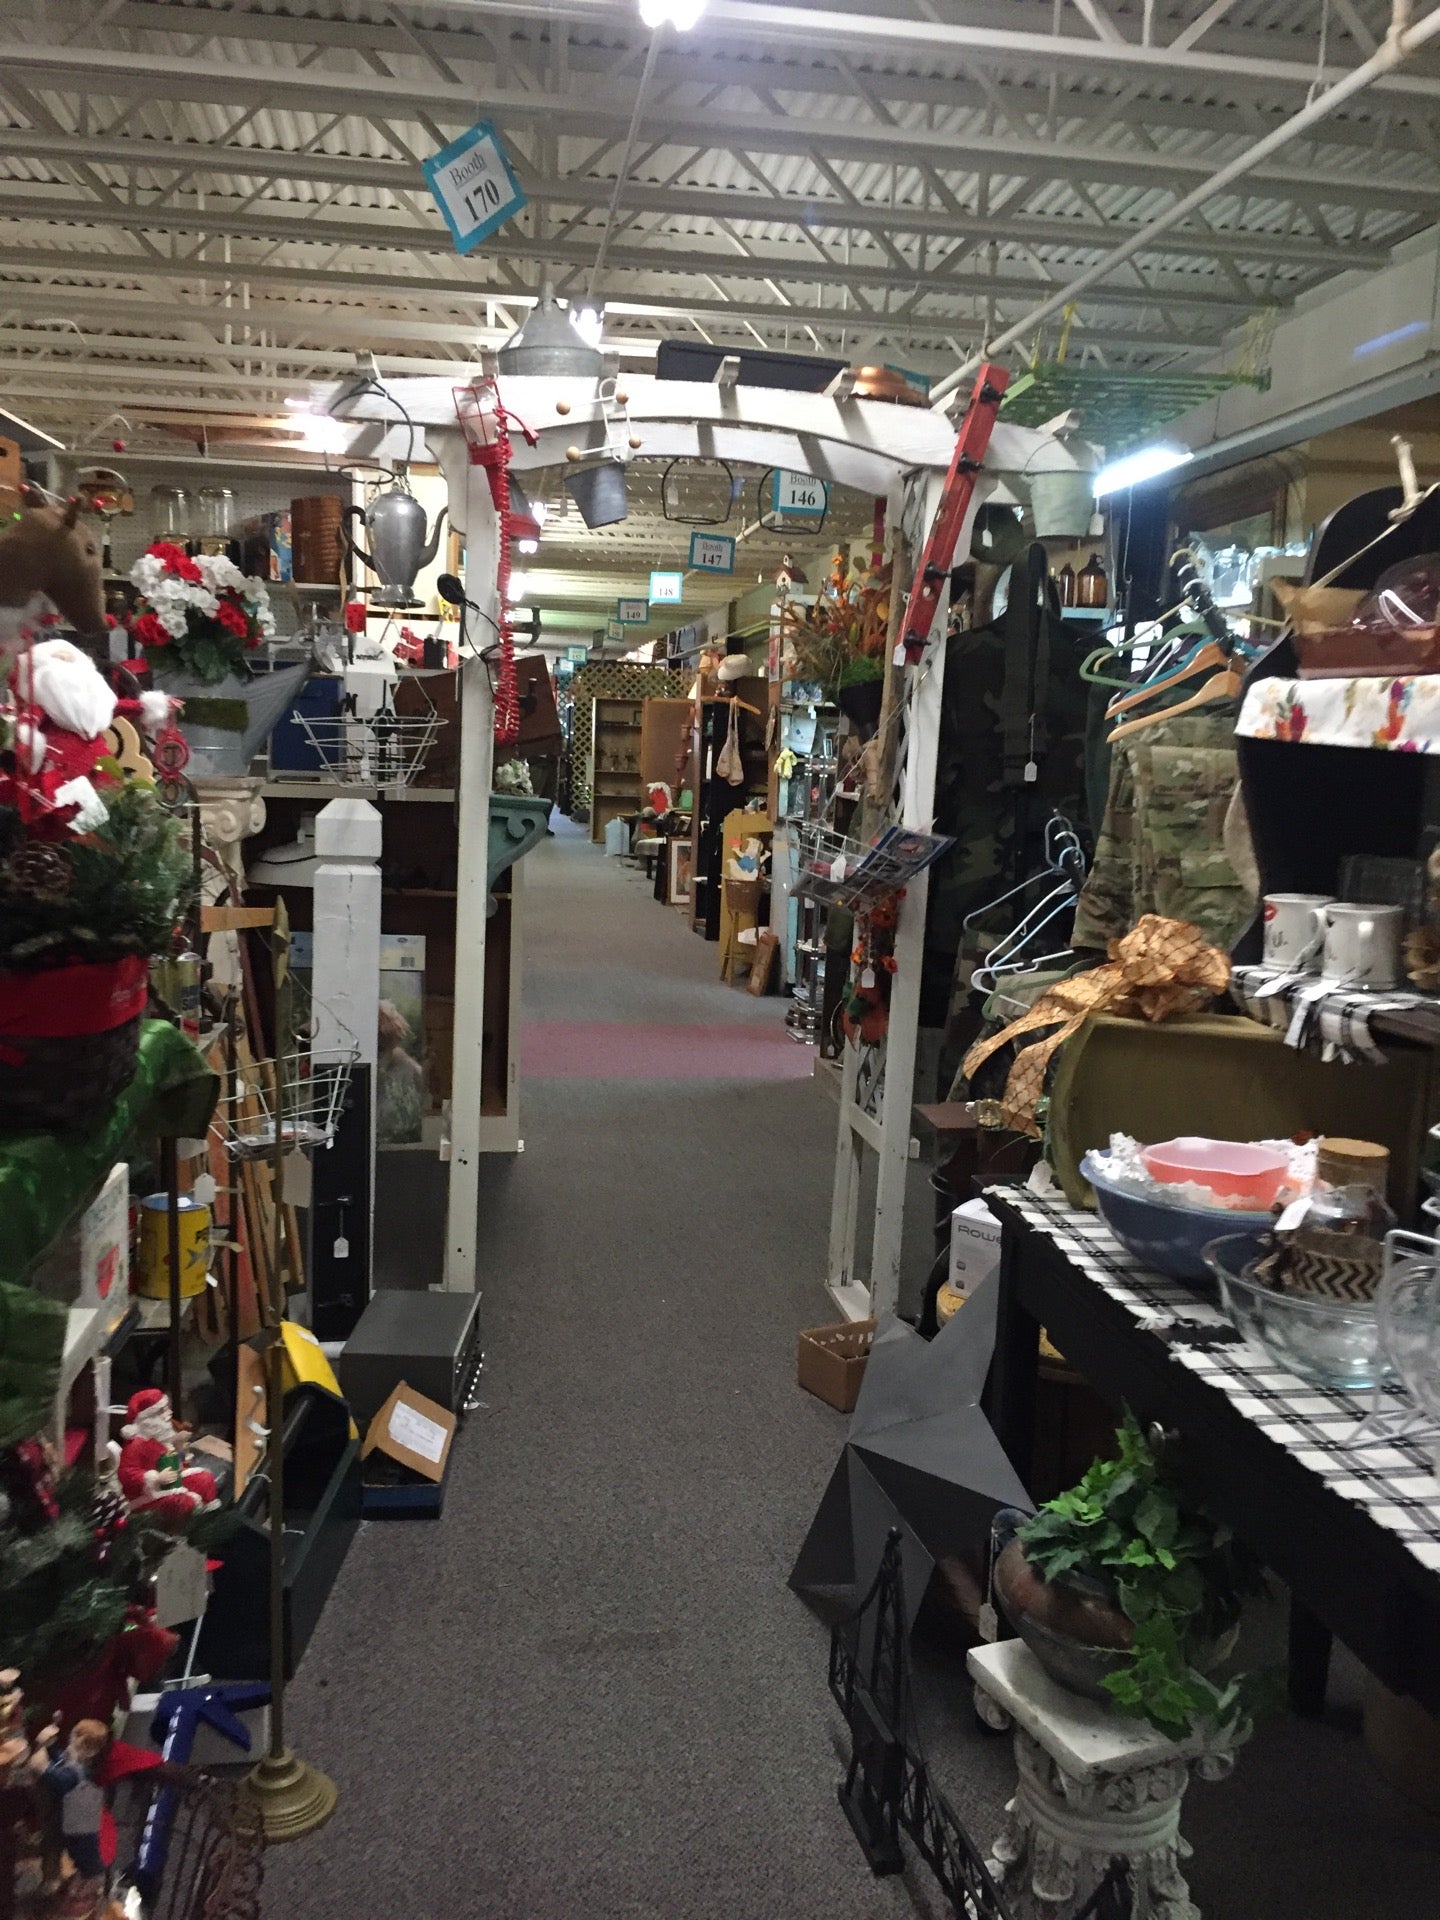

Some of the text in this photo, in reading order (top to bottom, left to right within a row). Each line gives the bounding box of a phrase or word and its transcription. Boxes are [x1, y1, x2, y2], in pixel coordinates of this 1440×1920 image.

[449, 152, 487, 186] Booth
[464, 178, 500, 222] 170
[791, 490, 816, 506] 146
[702, 553, 722, 566] 147
[659, 587, 674, 597] 148
[626, 610, 641, 619] 149
